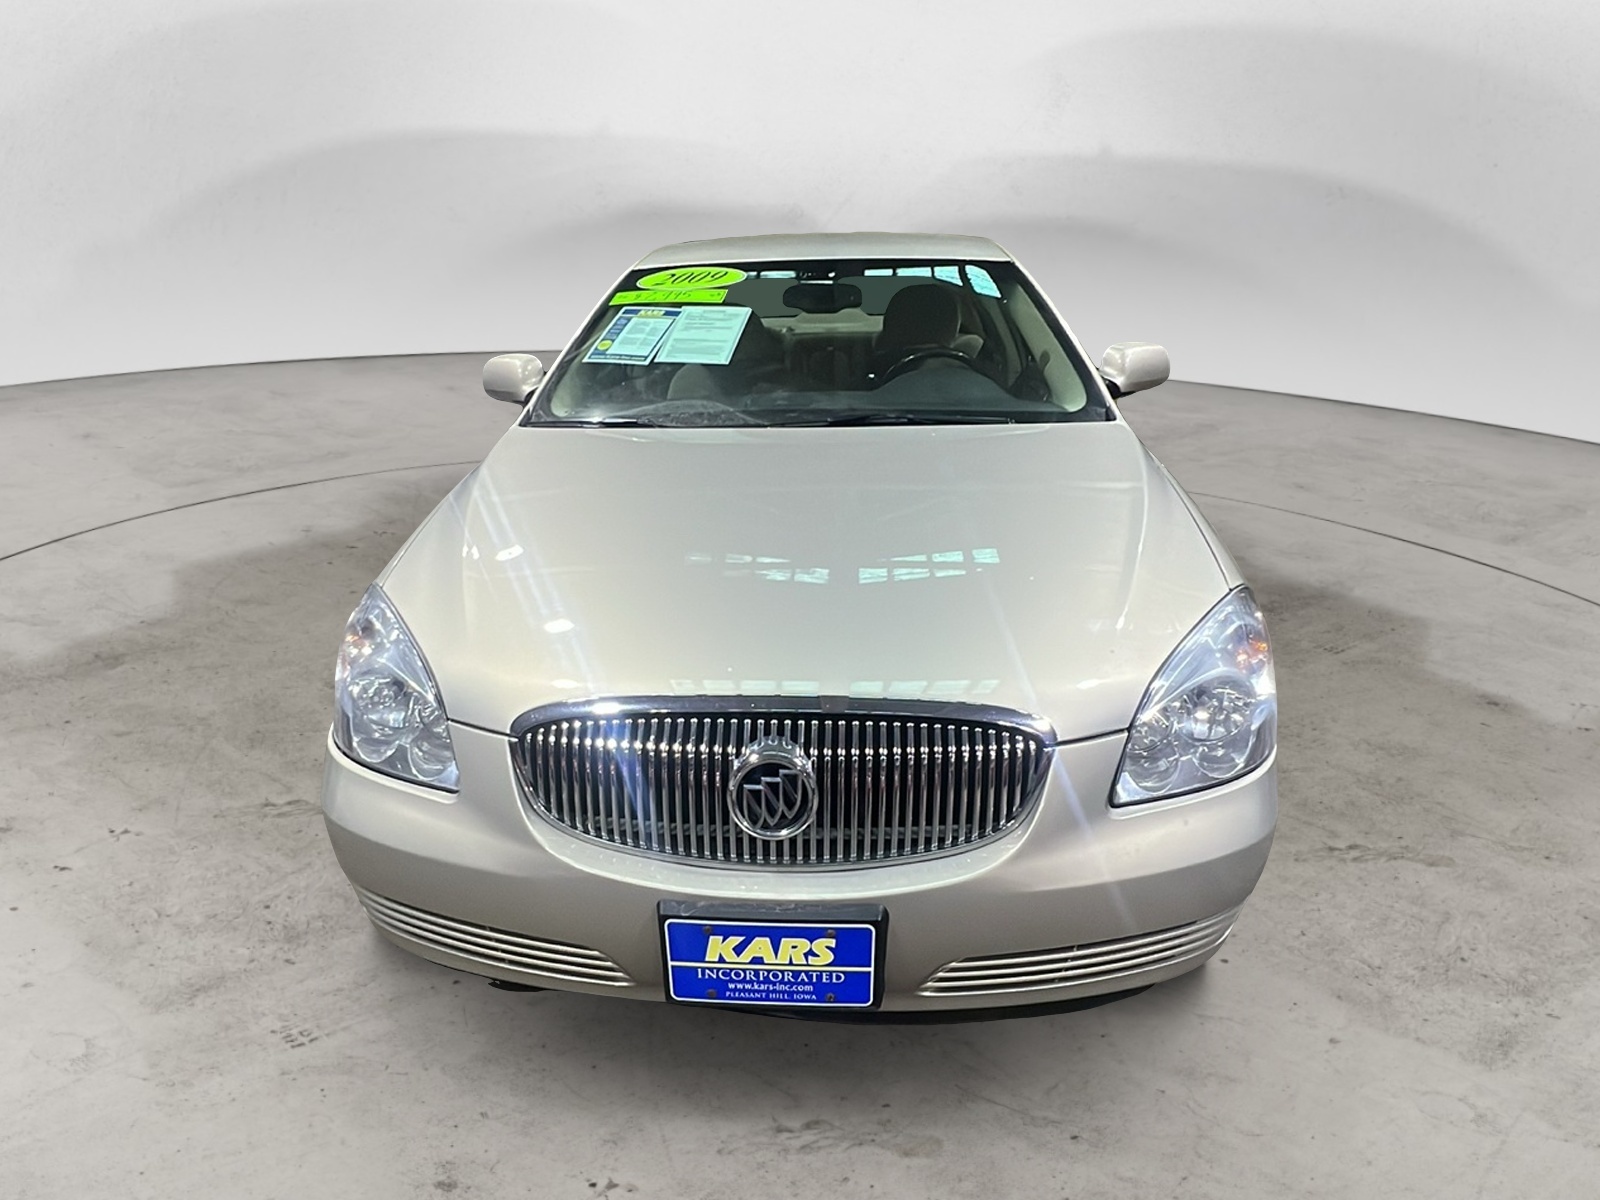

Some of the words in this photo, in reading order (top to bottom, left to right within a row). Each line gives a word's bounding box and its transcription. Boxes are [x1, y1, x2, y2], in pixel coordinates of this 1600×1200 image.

[652, 271, 728, 286] 2009
[705, 936, 836, 965] KARS
[697, 968, 845, 983] INCORPORATED
[728, 982, 813, 992] www.kars-inc.com
